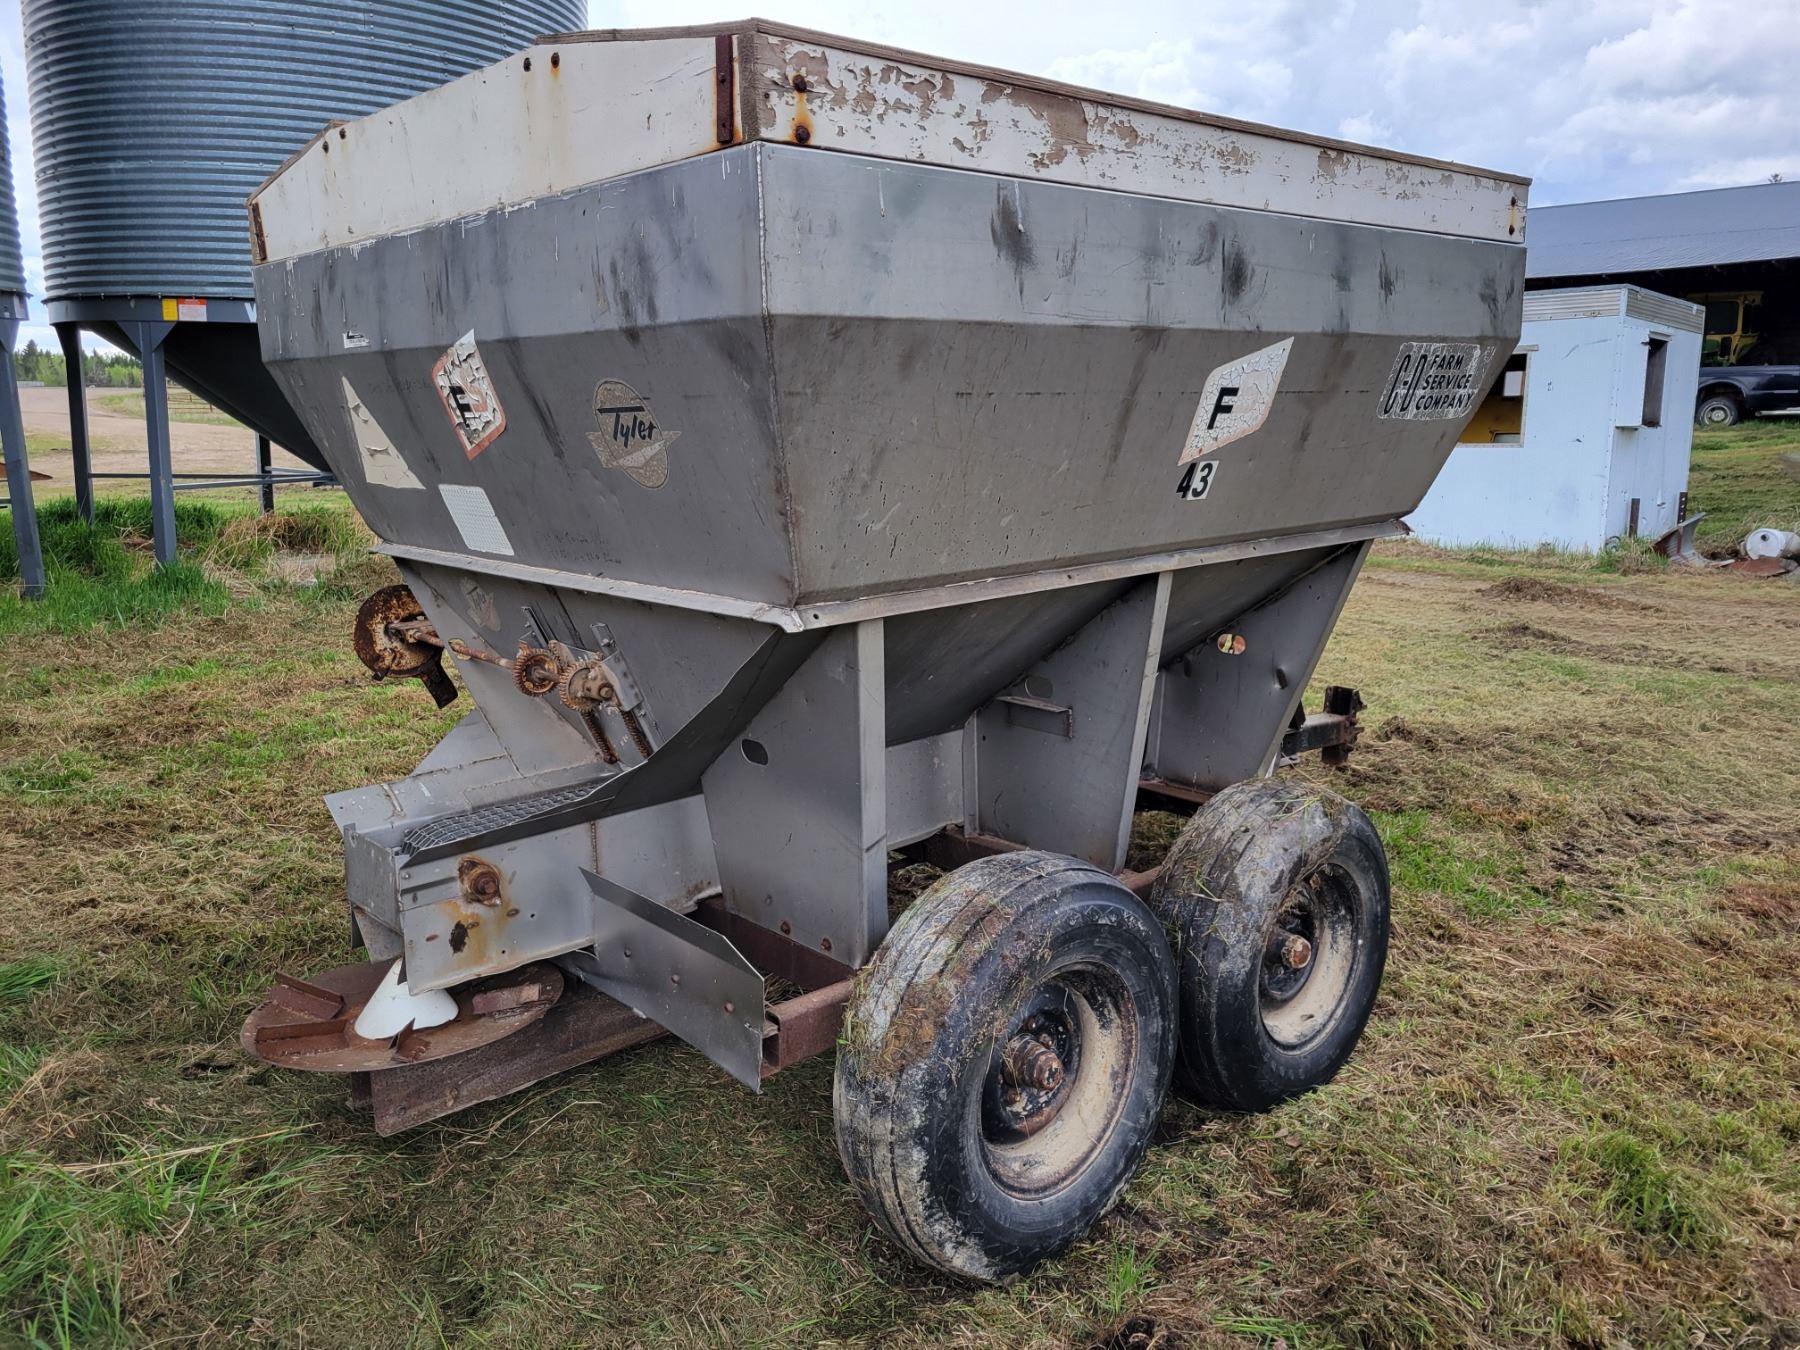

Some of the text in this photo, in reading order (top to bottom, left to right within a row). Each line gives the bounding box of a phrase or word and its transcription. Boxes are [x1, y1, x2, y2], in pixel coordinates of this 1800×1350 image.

[1429, 353, 1465, 371] FARM
[1421, 373, 1473, 391] SERVICE
[1206, 386, 1240, 430] F
[1414, 393, 1473, 411] COMPANY
[596, 405, 657, 449] Tyler
[1175, 462, 1214, 499] 43
